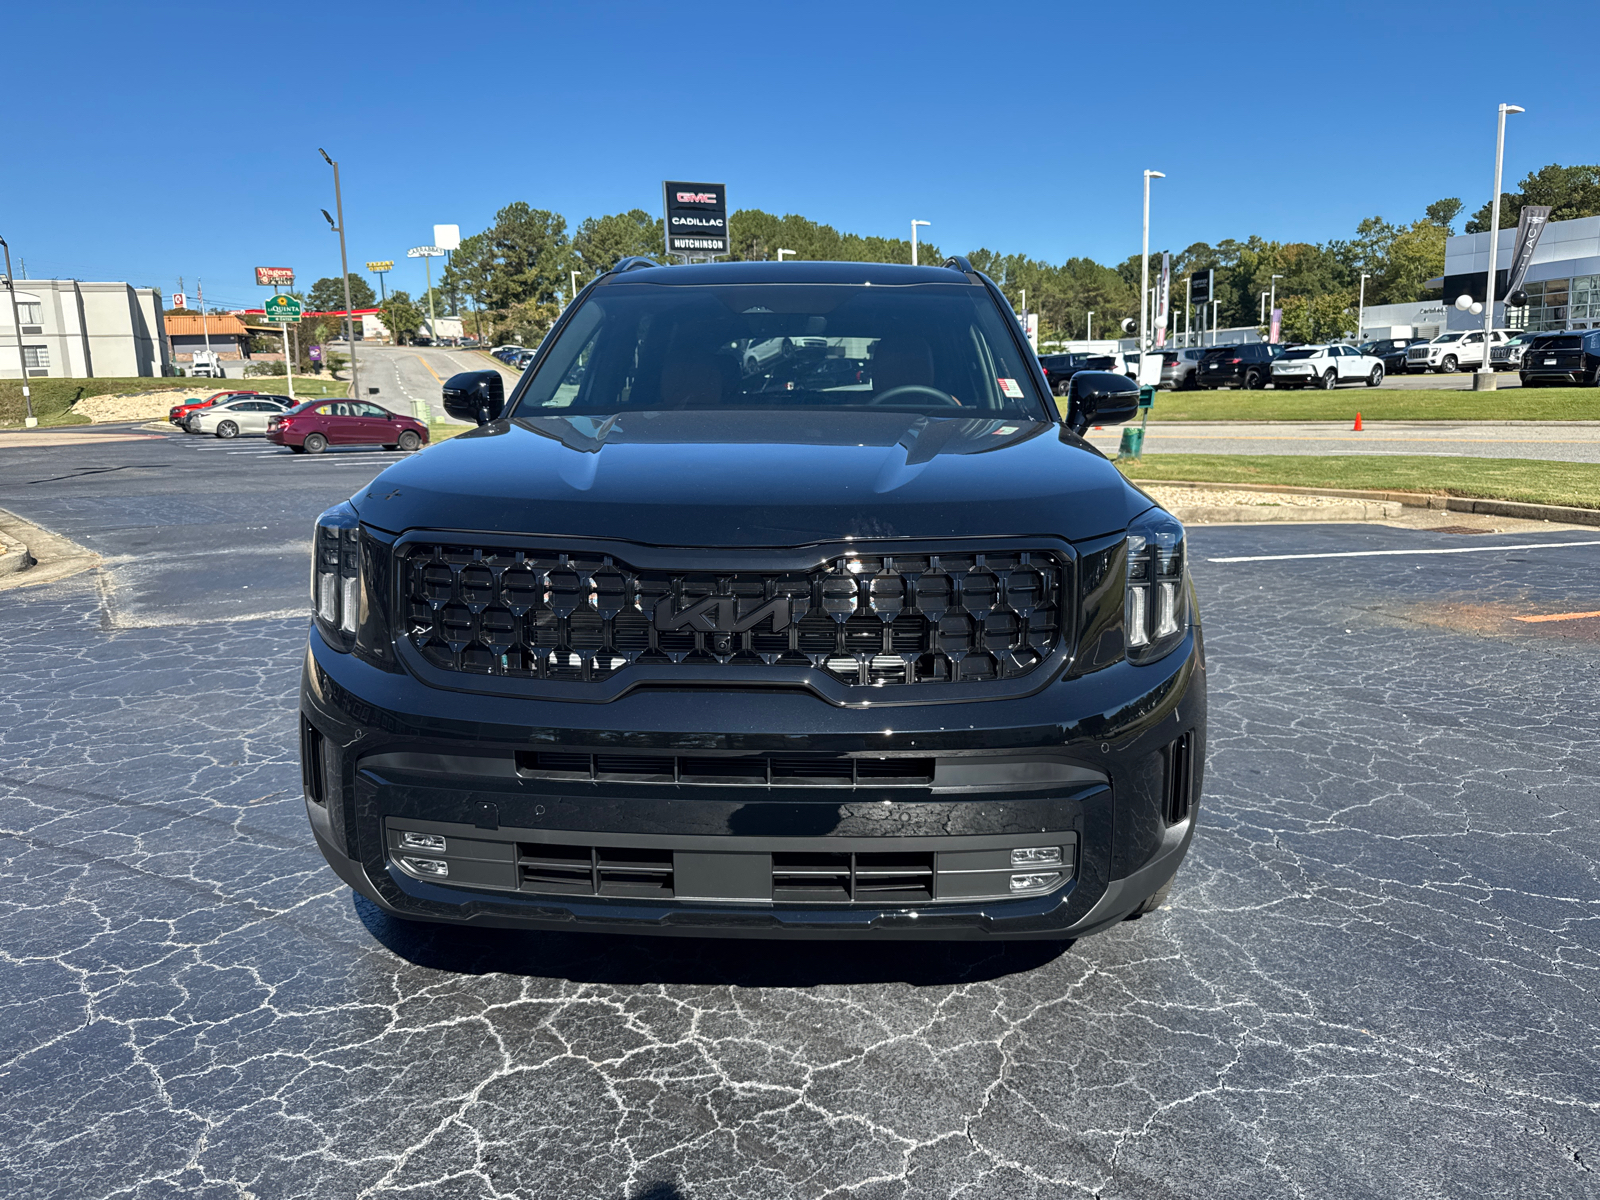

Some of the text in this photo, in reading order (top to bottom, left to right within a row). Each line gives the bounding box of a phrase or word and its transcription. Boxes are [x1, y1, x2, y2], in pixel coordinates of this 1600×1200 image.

[676, 192, 717, 204] GMC
[671, 216, 724, 227] CADILLAC
[674, 238, 723, 249] HUTCHINSON
[258, 267, 292, 277] Wagers
[654, 593, 792, 633] KIA
